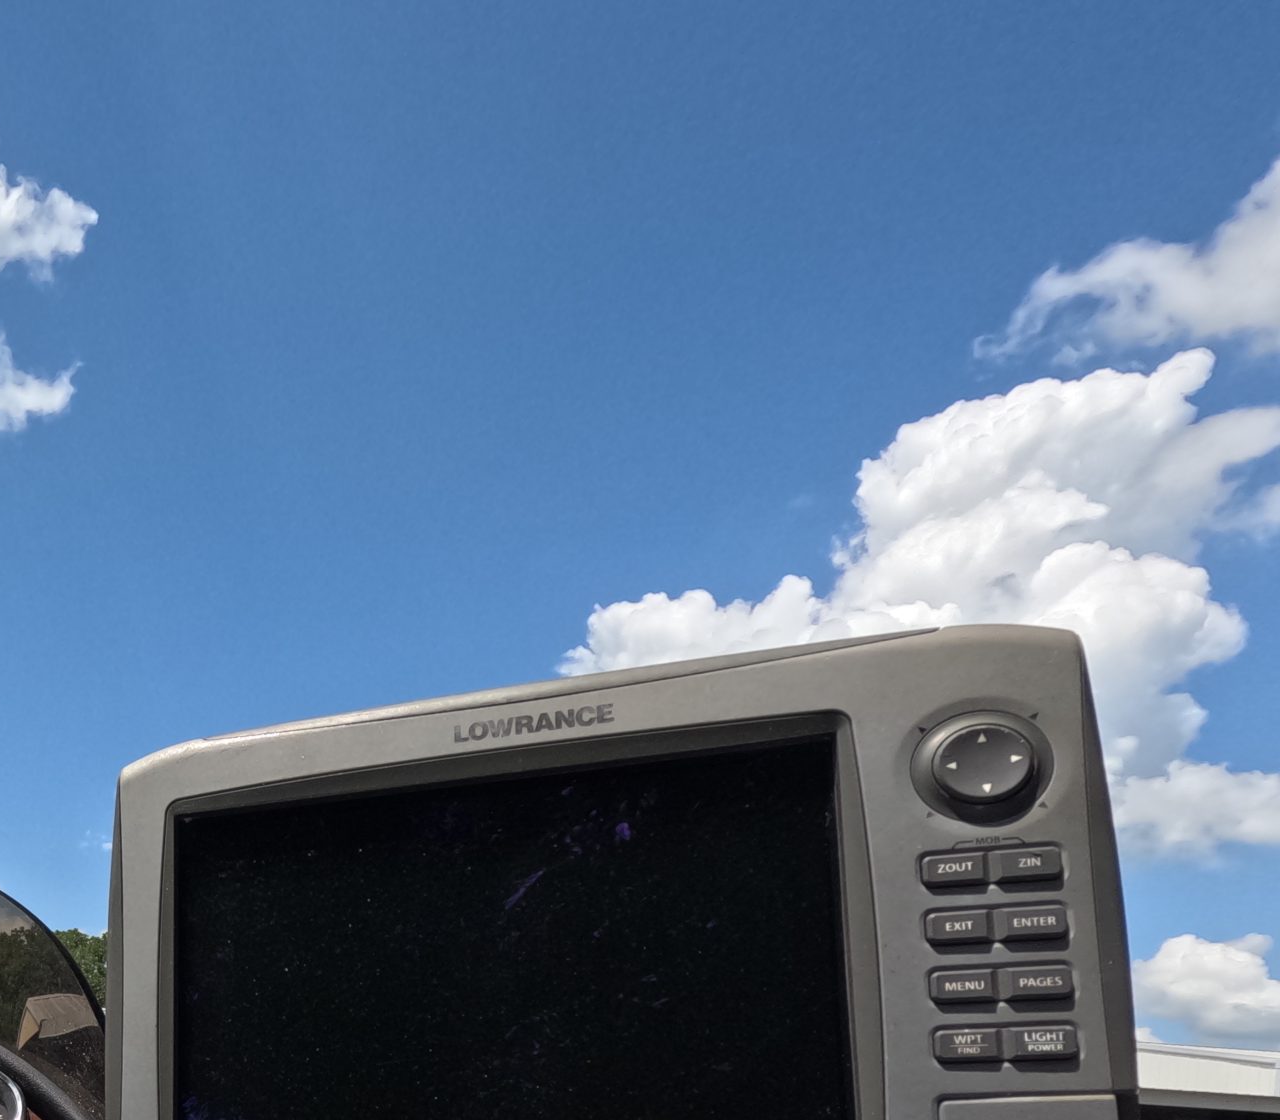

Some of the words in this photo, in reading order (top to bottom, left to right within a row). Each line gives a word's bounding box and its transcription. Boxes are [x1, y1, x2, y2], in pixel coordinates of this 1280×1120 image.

[453, 703, 615, 743] LOWRANCE
[975, 836, 1000, 846] MOB
[937, 861, 974, 873] ZOUT
[1018, 857, 1042, 868] ZIN
[945, 920, 974, 932] EXIT
[1013, 916, 1057, 928] ENTER
[945, 980, 985, 991] MENU
[1019, 976, 1063, 988] PAGES
[953, 1034, 983, 1045] WPT
[1024, 1031, 1065, 1042] LIGHT
[957, 1046, 981, 1054] FIND
[1027, 1044, 1064, 1052] POWER
